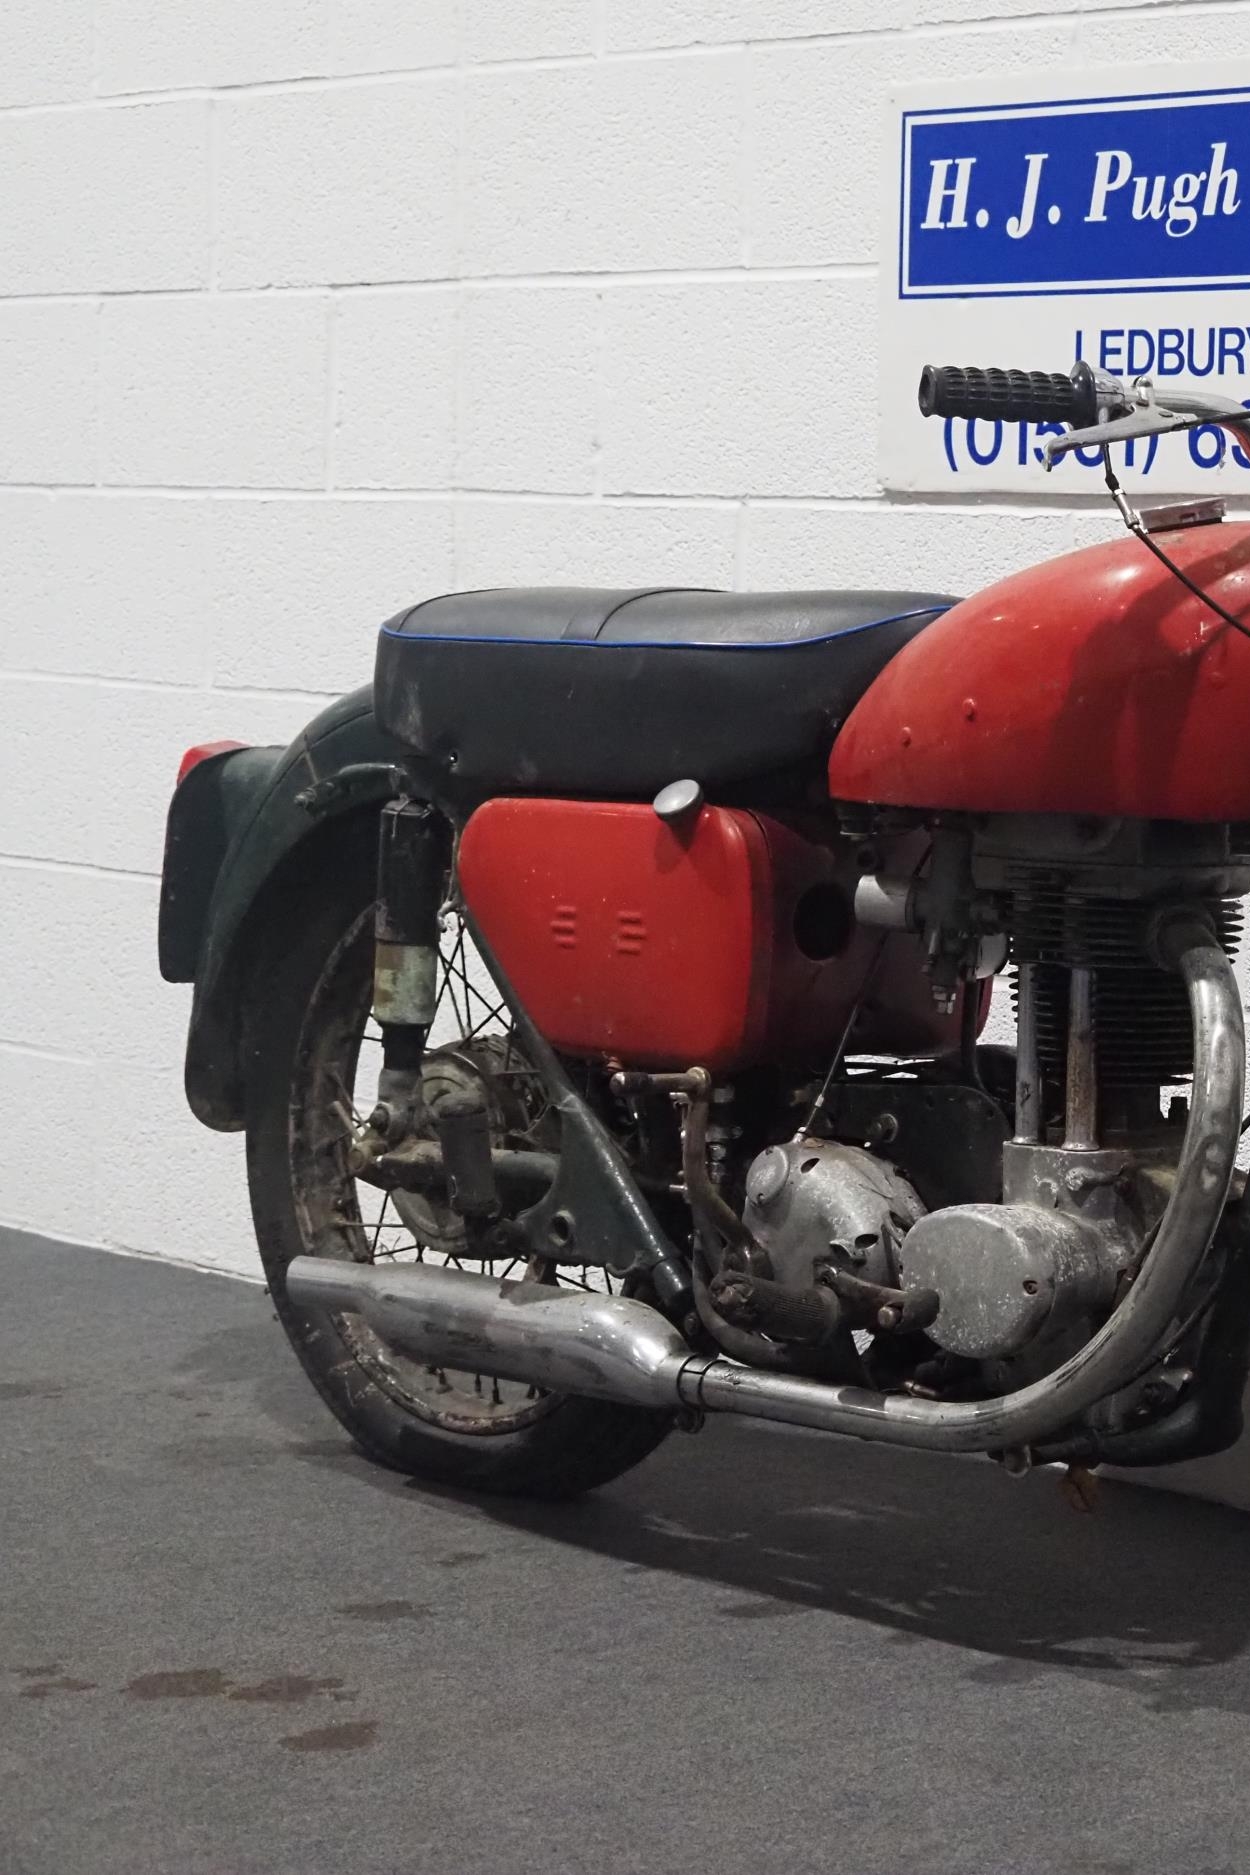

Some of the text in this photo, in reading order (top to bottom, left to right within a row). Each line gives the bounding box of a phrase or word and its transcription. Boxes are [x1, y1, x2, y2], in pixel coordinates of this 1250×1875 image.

[920, 157, 989, 230] H.
[1006, 153, 1062, 239] J.
[1083, 141, 1241, 238] Pugh
